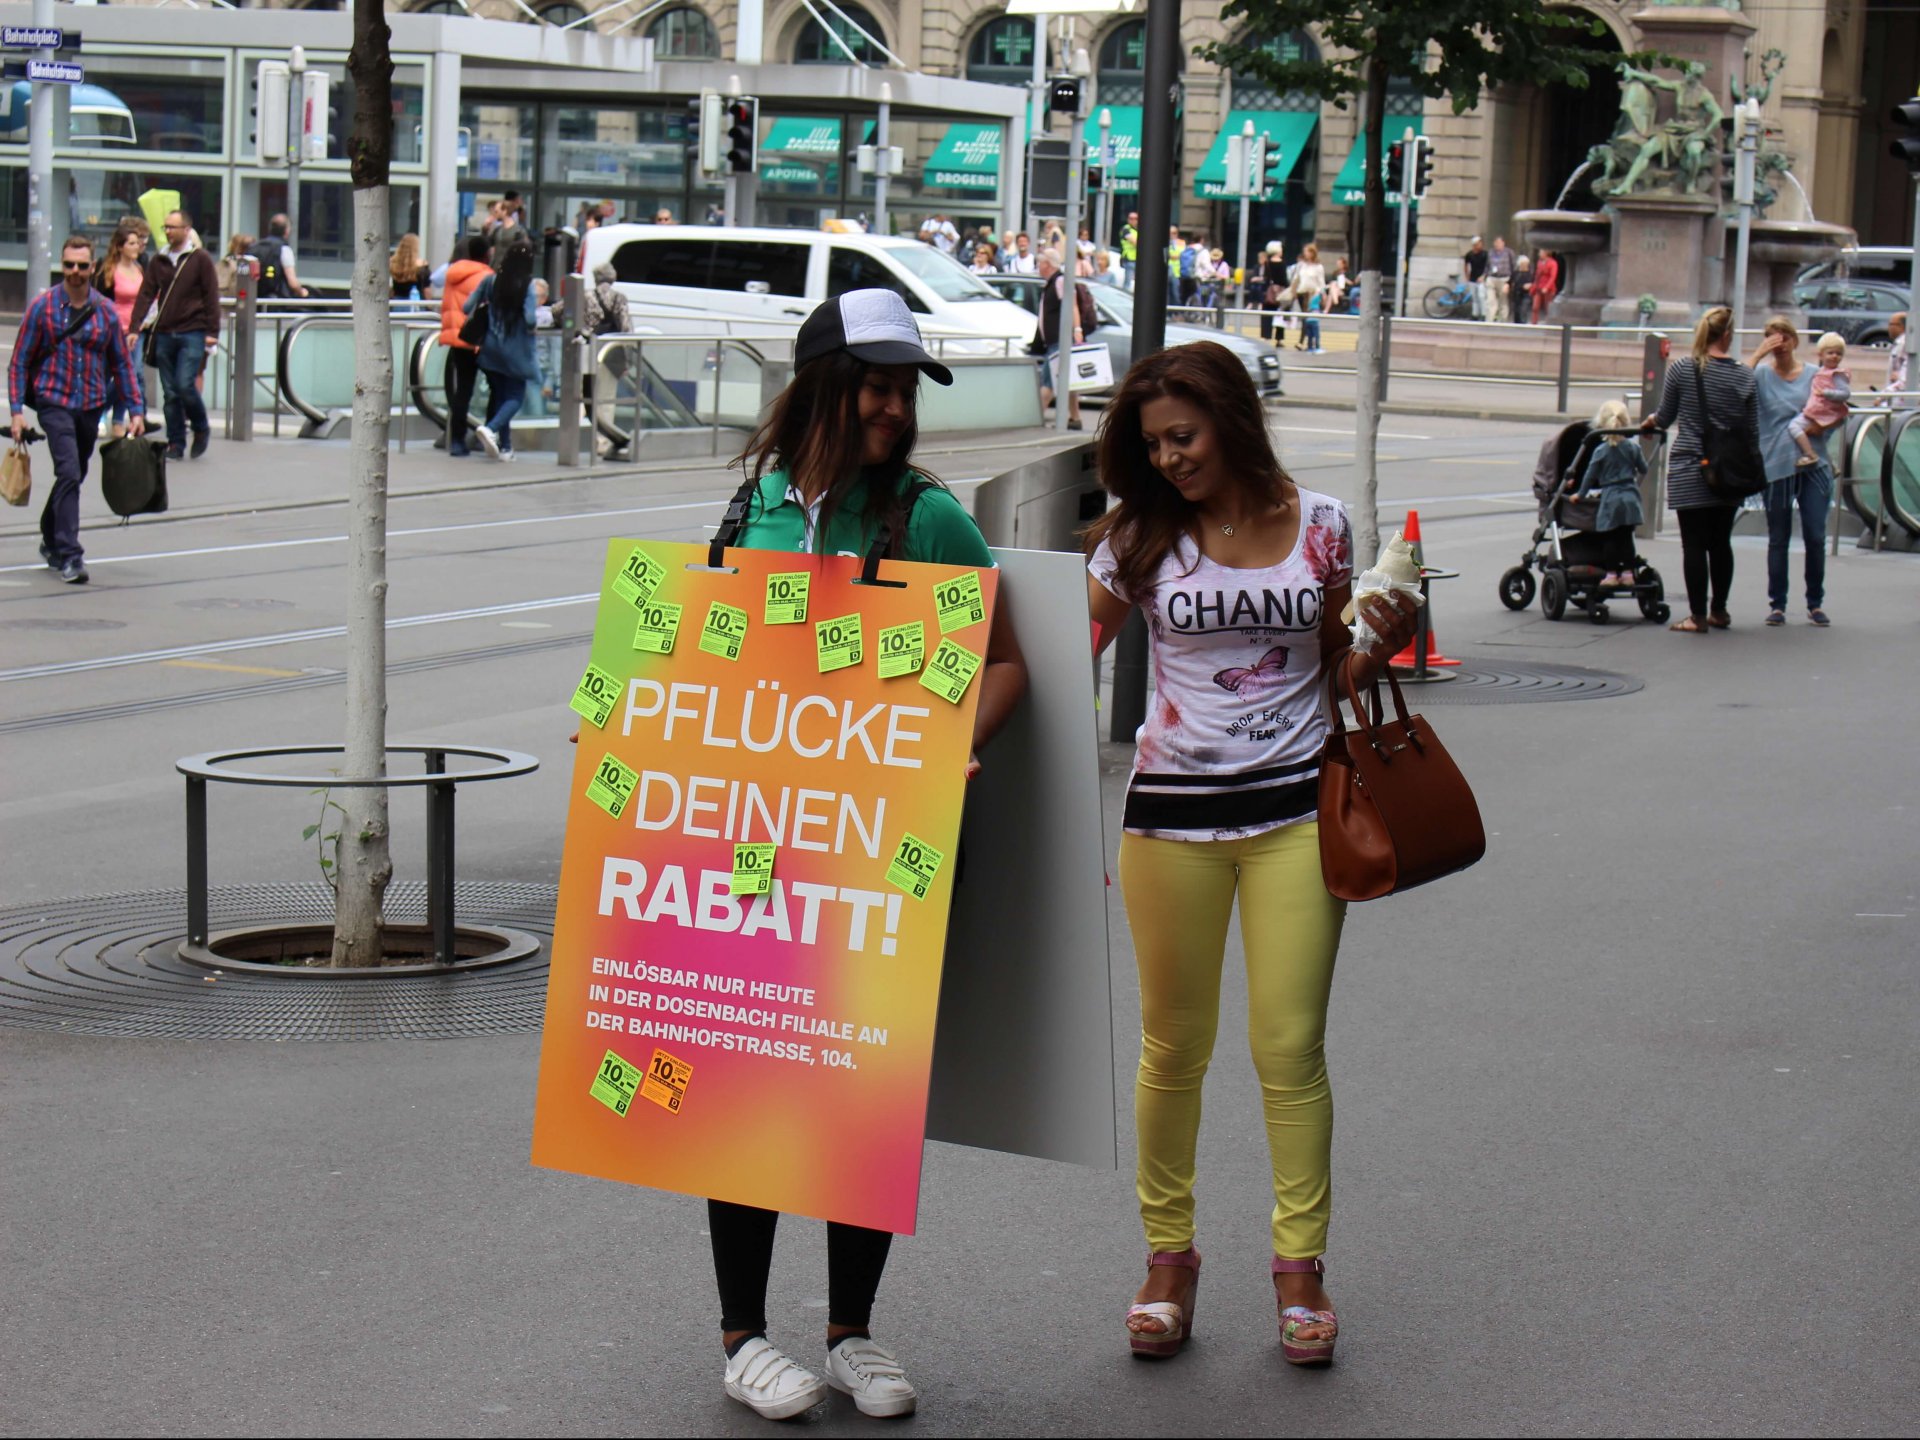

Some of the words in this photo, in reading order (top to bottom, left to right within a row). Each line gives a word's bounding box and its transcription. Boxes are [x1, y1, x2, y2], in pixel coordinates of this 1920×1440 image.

[5, 27, 58, 47] Bahnhofplatz
[31, 61, 81, 80] Bahnhofstrasse
[767, 168, 819, 180] APOTHE
[935, 172, 997, 187] DROGERIE
[622, 679, 930, 768] PFLÜCKE
[1226, 713, 1254, 737] DROP
[1262, 710, 1295, 731] EVERY
[1249, 729, 1276, 741] FEAR
[635, 770, 886, 859] DEINEN
[598, 856, 903, 956] RABATT!
[592, 957, 699, 988] EINLÖSBAR
[703, 974, 745, 996] NUR
[749, 980, 815, 1006] HEUTE
[589, 984, 609, 1003] IN
[613, 988, 652, 1009] DER
[656, 994, 776, 1029] DOSENBACH
[781, 1013, 854, 1041] FILIALE
[858, 1026, 888, 1046] AN
[586, 1011, 625, 1032] DER
[628, 1017, 815, 1066] BAHNHOFSTRASSE,
[821, 1049, 857, 1070] 104.
